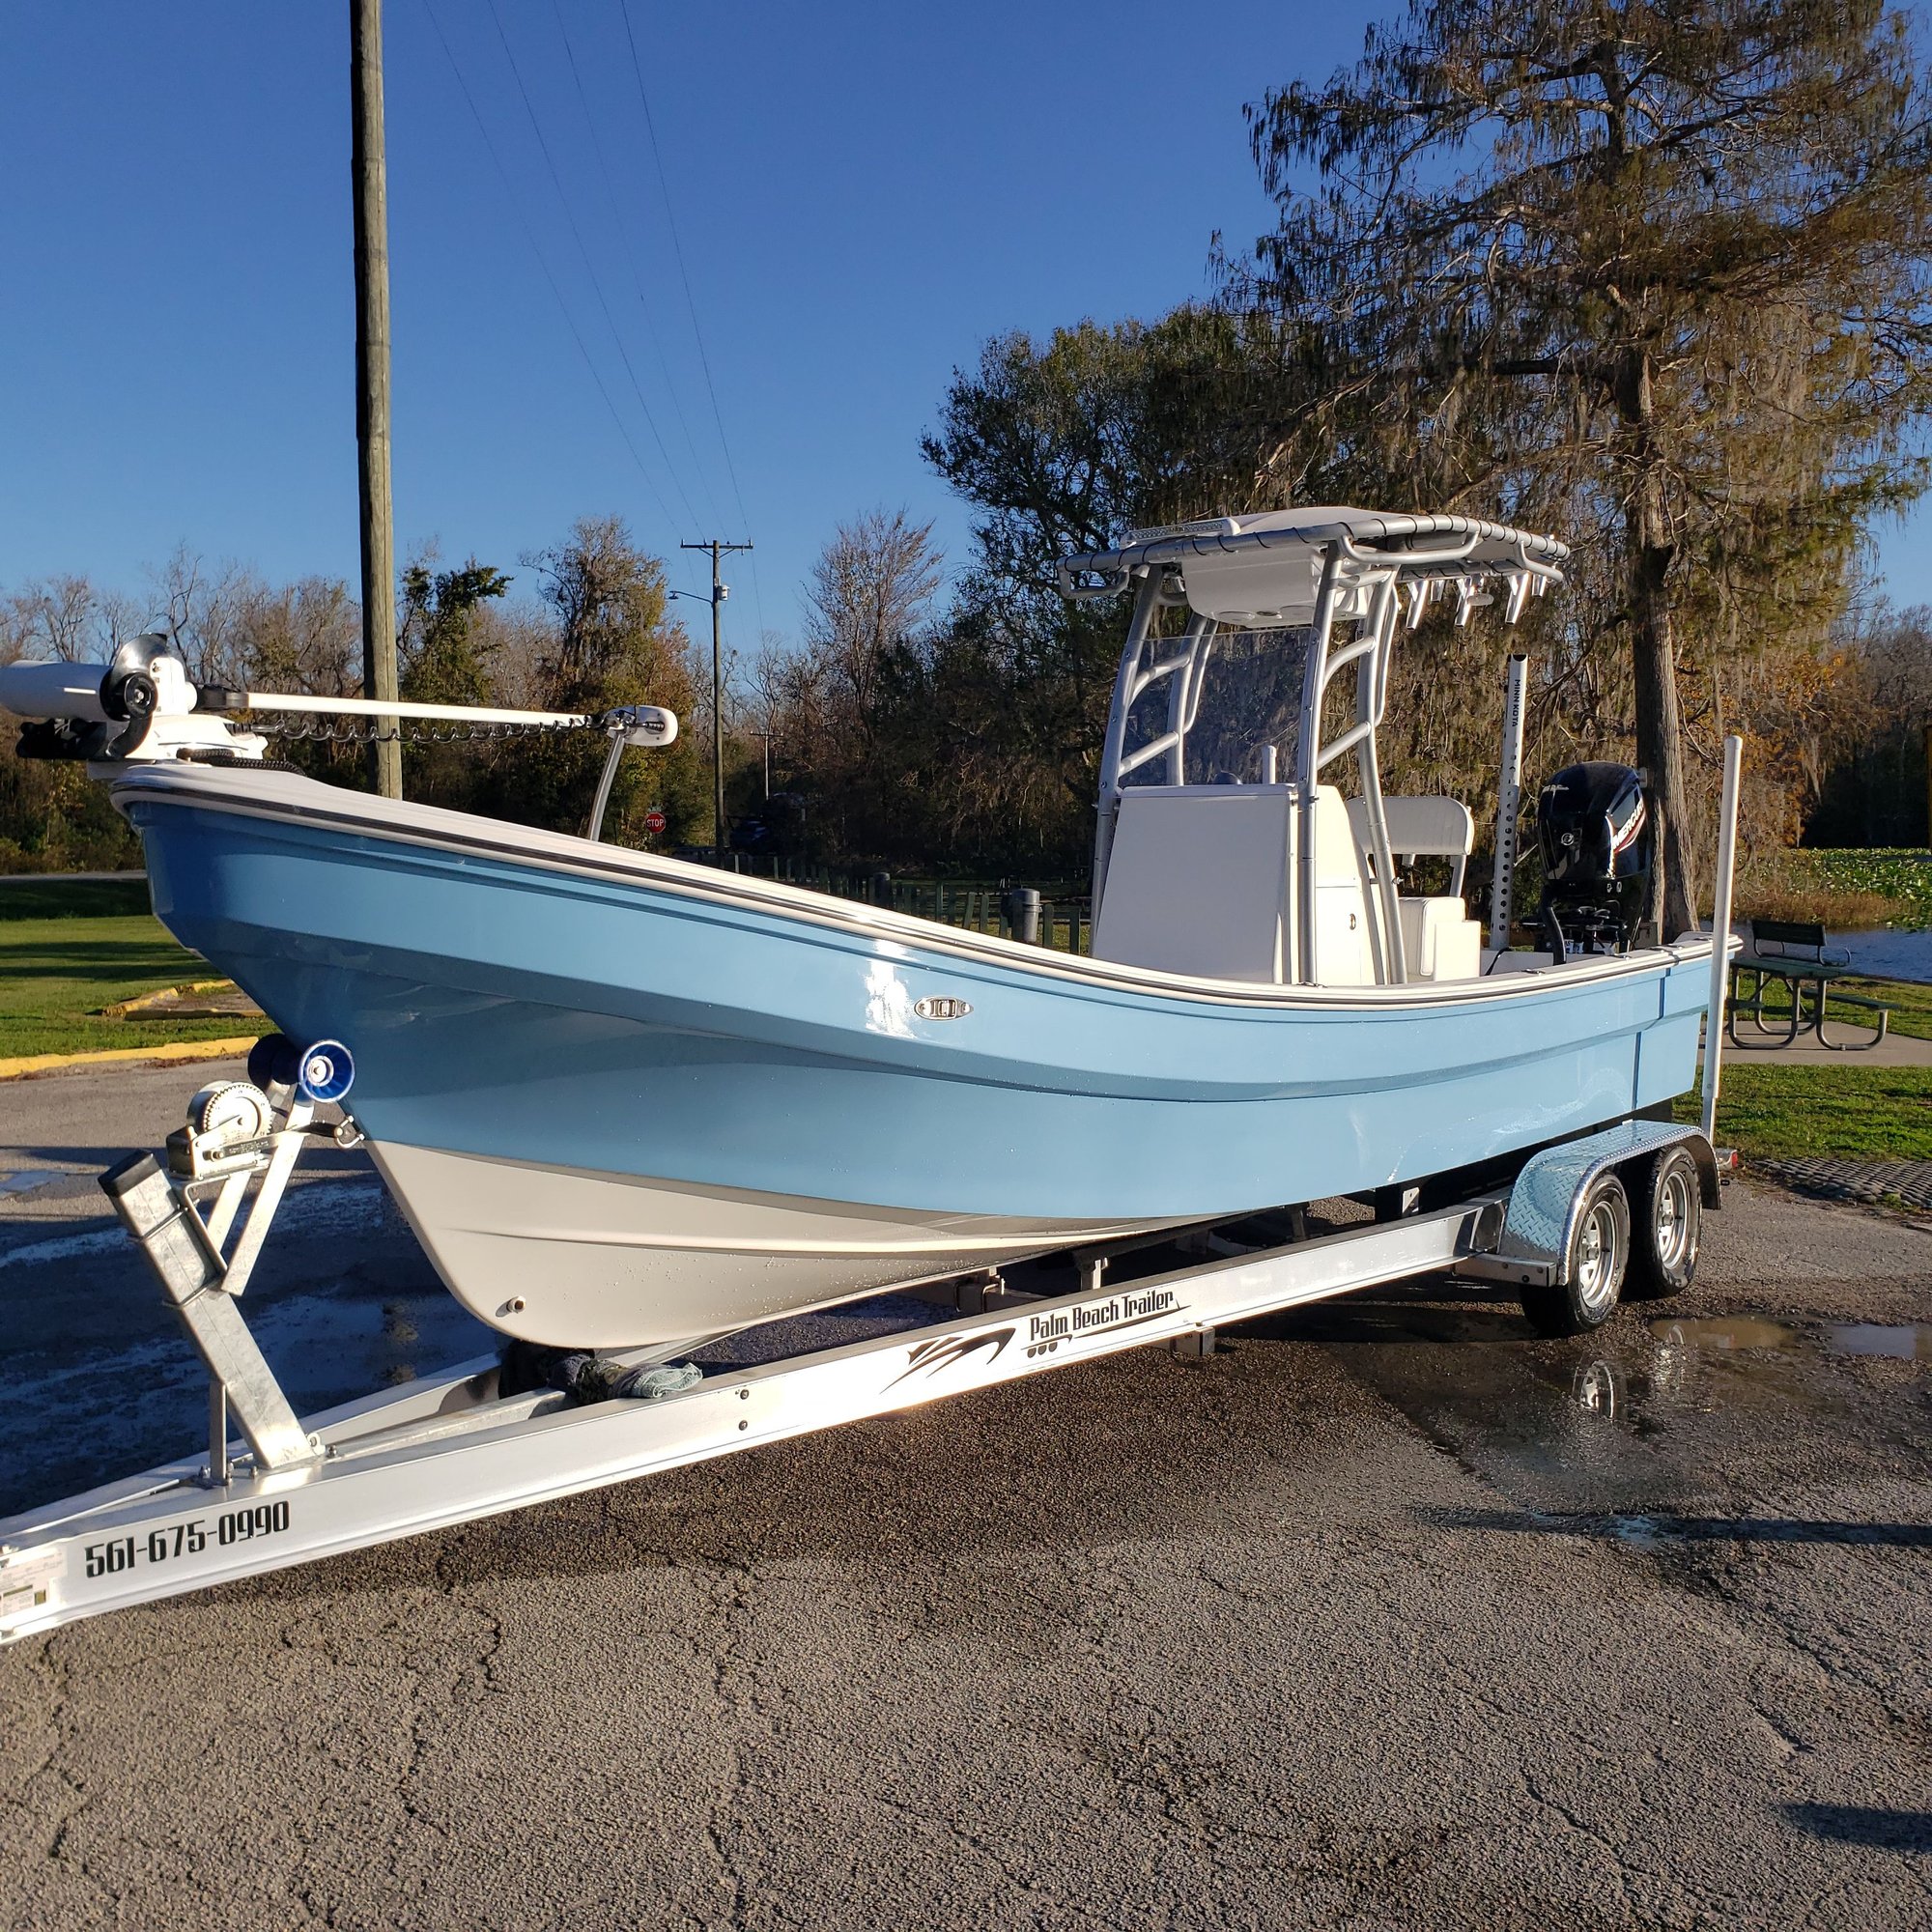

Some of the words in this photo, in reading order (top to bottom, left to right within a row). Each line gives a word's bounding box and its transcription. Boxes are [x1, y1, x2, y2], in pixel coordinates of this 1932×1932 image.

[646, 818, 665, 828] STOP
[1612, 797, 1644, 851] MERCUR
[1030, 1313, 1068, 1341] Palm
[1072, 1299, 1119, 1331] Beach
[1122, 1290, 1174, 1318] Trailer
[84, 1500, 290, 1578] 561-675-0990
